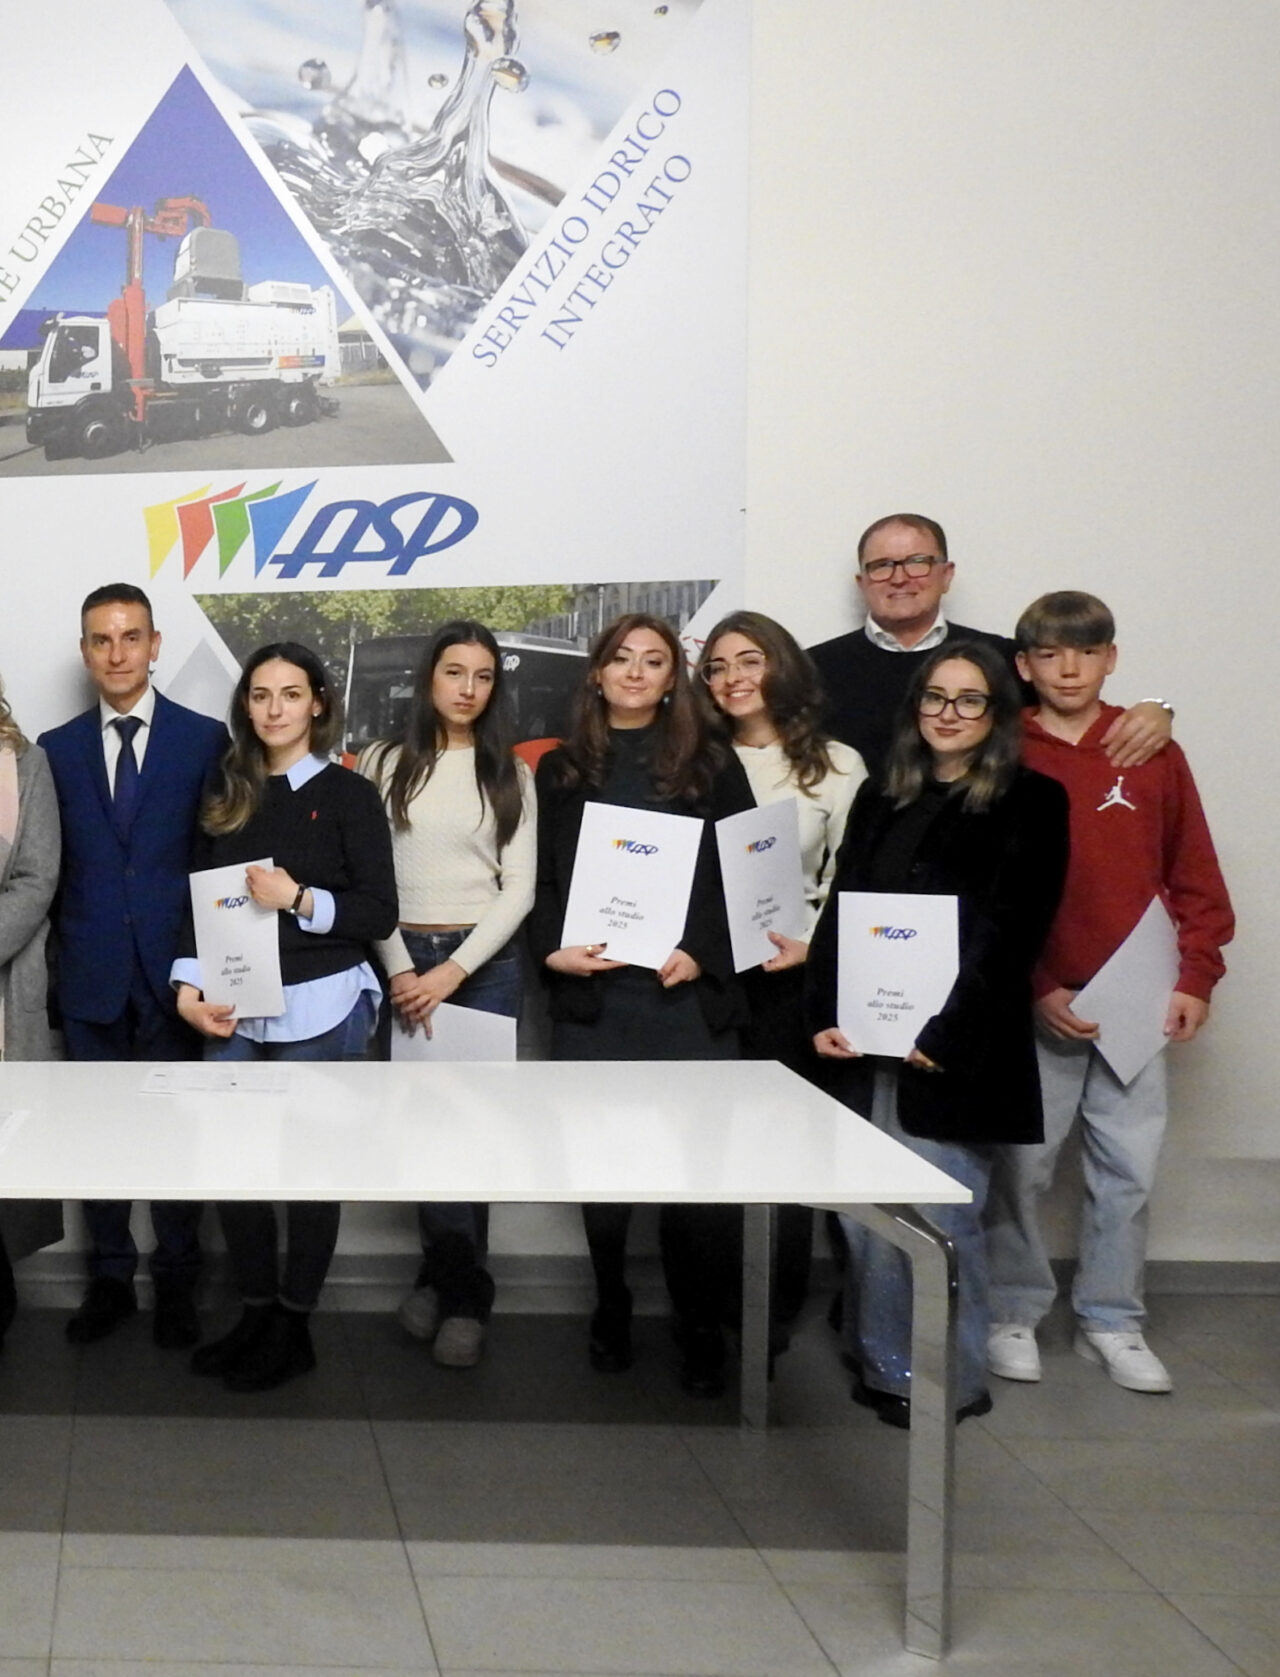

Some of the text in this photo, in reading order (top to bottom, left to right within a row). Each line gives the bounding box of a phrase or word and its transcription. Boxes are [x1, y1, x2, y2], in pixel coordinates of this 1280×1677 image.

[8, 132, 114, 262] URBANA
[472, 88, 682, 368] SERVIZIO IDRICO
[540, 155, 692, 351] INTEGRATO
[269, 491, 479, 579] ASP
[876, 987, 904, 998] Premi
[876, 1012, 899, 1022] 2025
